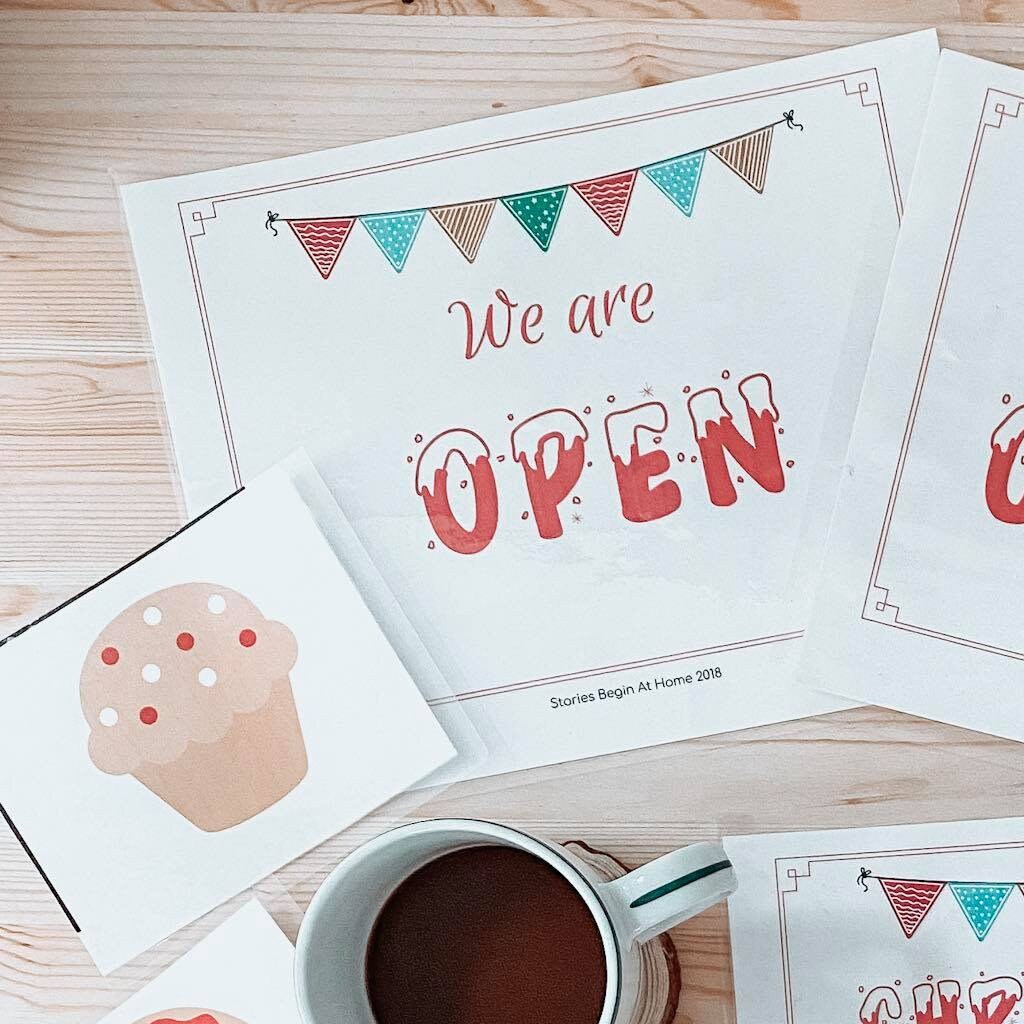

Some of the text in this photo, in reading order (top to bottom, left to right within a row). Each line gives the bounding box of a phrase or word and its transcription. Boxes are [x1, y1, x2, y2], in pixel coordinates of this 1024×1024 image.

[447, 280, 656, 360] We are
[415, 373, 787, 555] OPEN
[549, 667, 723, 709] Stories Begin At Home 2018
